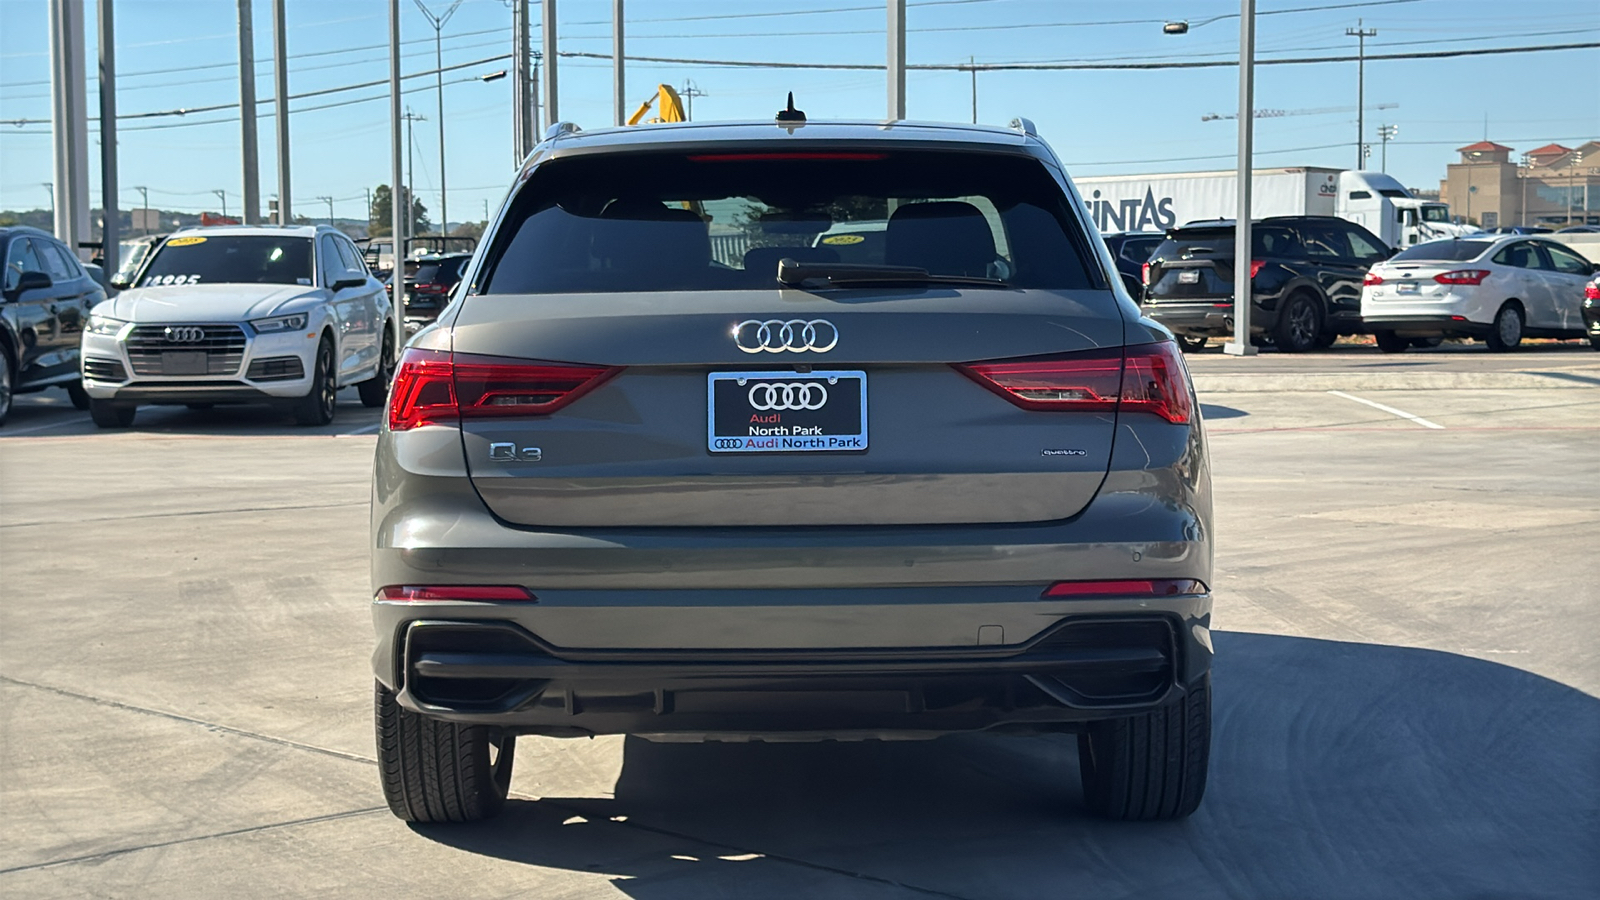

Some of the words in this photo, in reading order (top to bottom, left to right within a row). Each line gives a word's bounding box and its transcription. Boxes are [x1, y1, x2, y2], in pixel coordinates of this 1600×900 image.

[1085, 184, 1176, 232] INTAS
[750, 413, 781, 424] Audi
[749, 426, 789, 436] North
[792, 425, 823, 436] Park
[745, 438, 779, 449] Audi
[782, 437, 825, 448] North
[829, 437, 861, 448] Park
[490, 442, 541, 462] Q3
